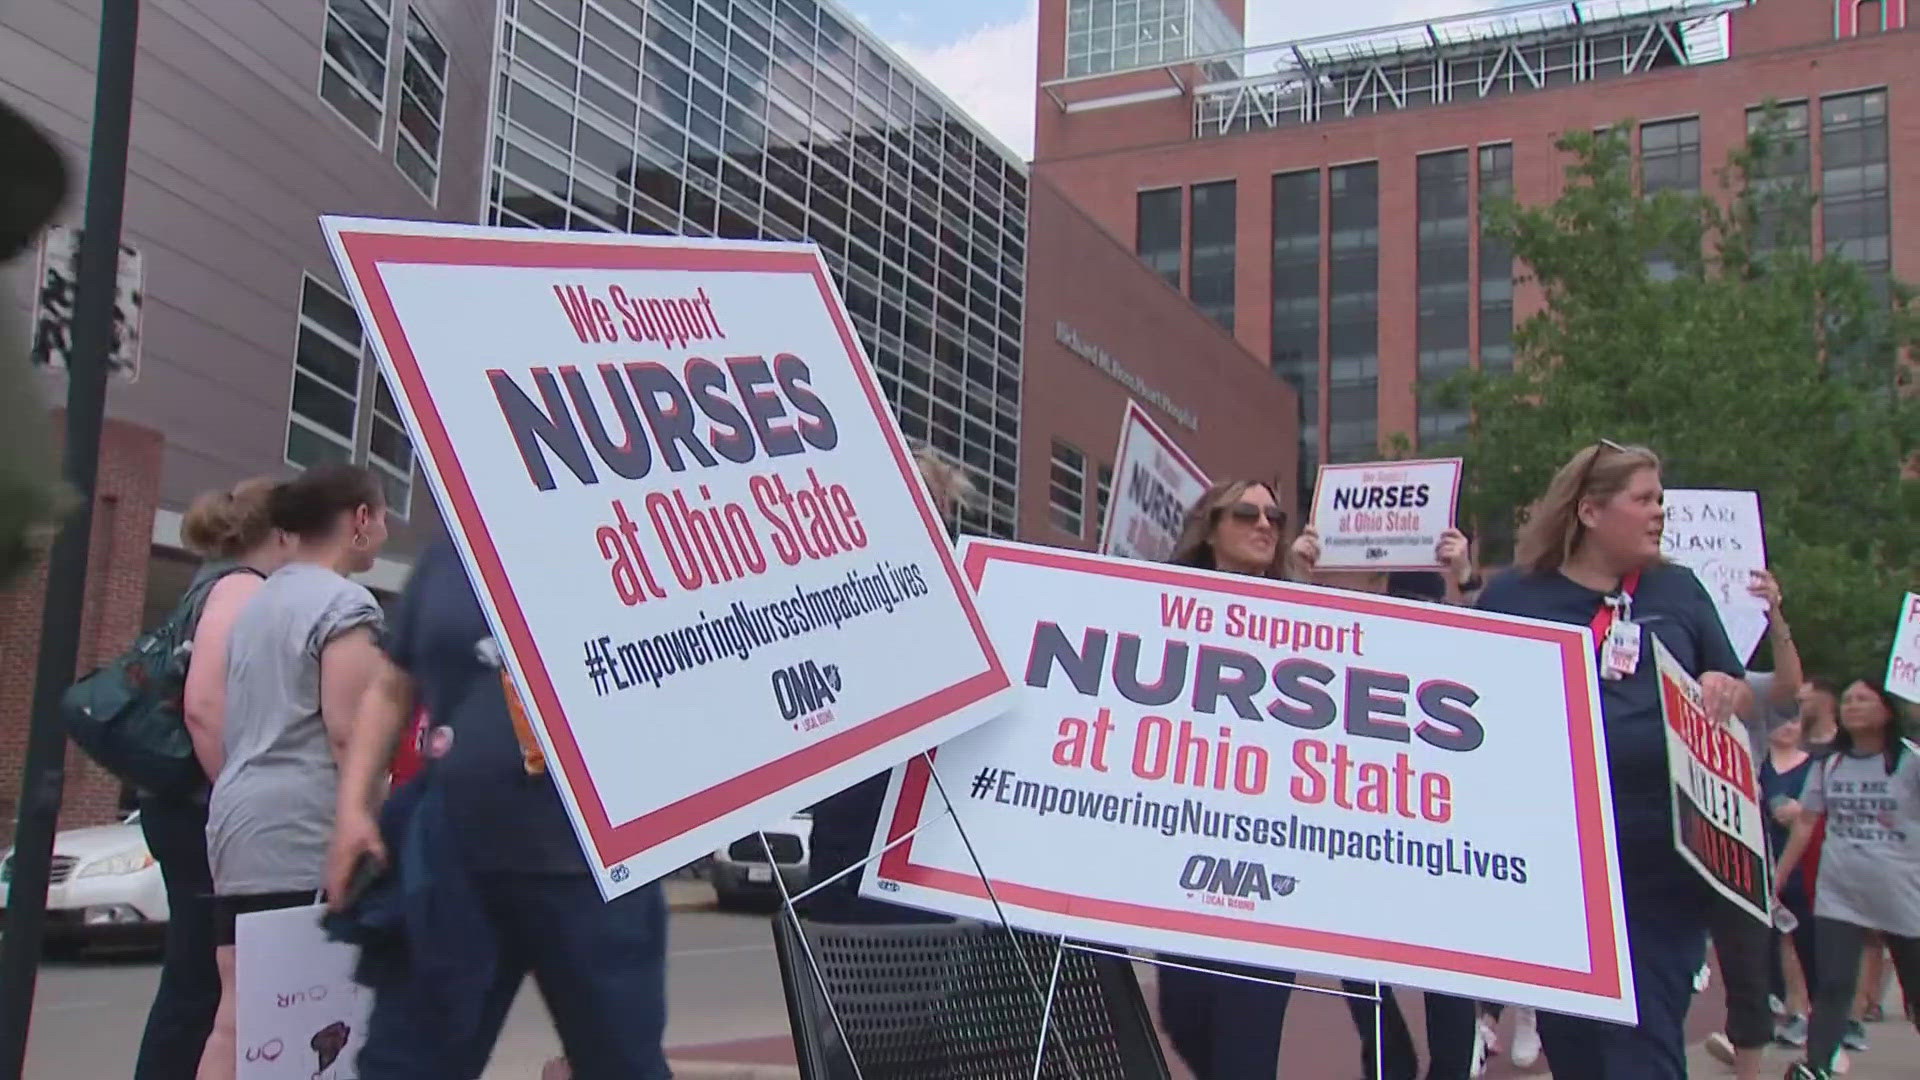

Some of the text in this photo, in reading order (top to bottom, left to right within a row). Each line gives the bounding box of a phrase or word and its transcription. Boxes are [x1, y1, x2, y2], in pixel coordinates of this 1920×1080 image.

[553, 284, 726, 350] We Support
[485, 353, 839, 492] NURSES
[1128, 459, 1184, 541] NURSE
[1333, 484, 1430, 510] NURSES
[1355, 512, 1383, 532] Ohio
[1386, 511, 1420, 532] State
[1666, 505, 1693, 522] ES
[595, 468, 868, 606] at Ohio State
[1662, 530, 1743, 551] SLAVES
[583, 560, 929, 697] #EmpoweringNursesImpactingLives
[1159, 592, 1364, 656] We Support
[772, 659, 836, 721] ONA
[1024, 620, 1485, 752] NURSES
[1052, 707, 1452, 824] at Ohio State
[970, 766, 1528, 884] #EmpoweringNursesImpactingLives
[1180, 854, 1271, 901] ONA
